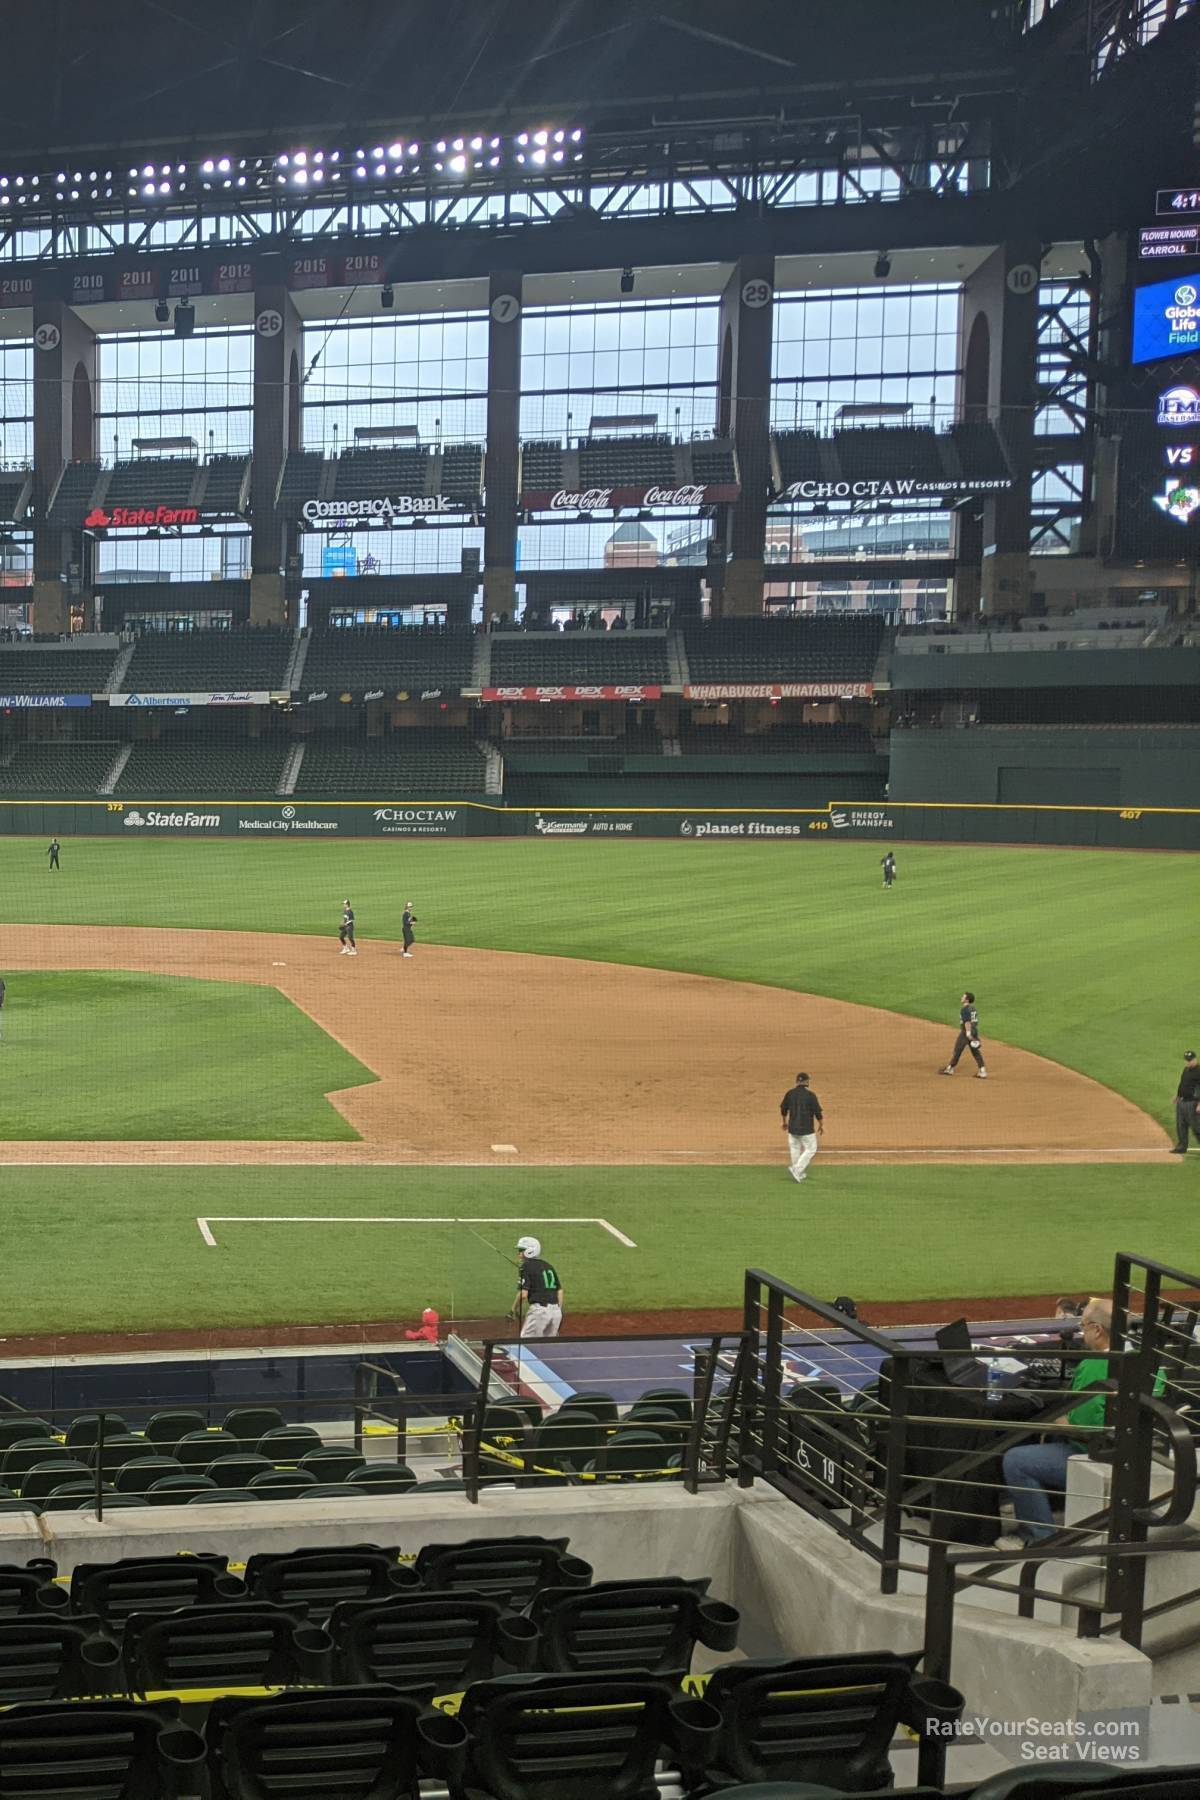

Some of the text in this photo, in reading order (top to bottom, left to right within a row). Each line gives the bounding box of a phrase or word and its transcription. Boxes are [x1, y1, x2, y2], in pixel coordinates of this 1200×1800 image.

[1141, 229, 1197, 241] FLOWER MOUND
[1141, 245, 1187, 256] CARROLL
[294, 258, 326, 273] 2015
[345, 255, 378, 270] 2016
[122, 271, 151, 285] 2011
[170, 268, 200, 283] 2011
[219, 263, 251, 279] 2012
[1011, 269, 1032, 287] 10
[2, 279, 33, 293] 2010
[73, 275, 104, 289] 2010
[746, 285, 768, 302] 29
[499, 300, 511, 317] 7
[258, 316, 279, 331] 26
[1172, 319, 1197, 331] Life
[38, 330, 57, 345] 34
[1169, 331, 1198, 344] Field
[1166, 447, 1193, 465] VS
[643, 484, 708, 506] Coca-Cola
[800, 479, 916, 498] CHOCTAW
[915, 482, 958, 491] CASINOS
[968, 480, 1012, 489] RESORTS
[398, 494, 452, 513] Bank
[550, 487, 614, 510] Coca-Cola
[496, 688, 525, 696] DEX
[536, 687, 564, 695] DEX
[575, 686, 603, 694] DEX
[615, 686, 643, 694] DEX
[688, 686, 773, 699] WHATABURGER
[780, 684, 867, 698] WHATABURGER
[143, 696, 191, 705] Albertsons
[209, 693, 254, 702] Tom Thumb
[107, 803, 124, 812] 372
[382, 809, 457, 821] CHOCTAW
[851, 811, 885, 819] ENERGY
[1120, 810, 1142, 820] 407
[239, 819, 338, 832] Medical City Healthcare
[551, 820, 588, 830] Germania
[592, 823, 607, 831] AUTO
[615, 822, 633, 831] HOME
[696, 822, 801, 837] planet fitness
[808, 822, 828, 830] 410
[851, 819, 893, 828] TRANSFER
[543, 1269, 557, 1289] 12
[822, 1456, 836, 1485] 19
